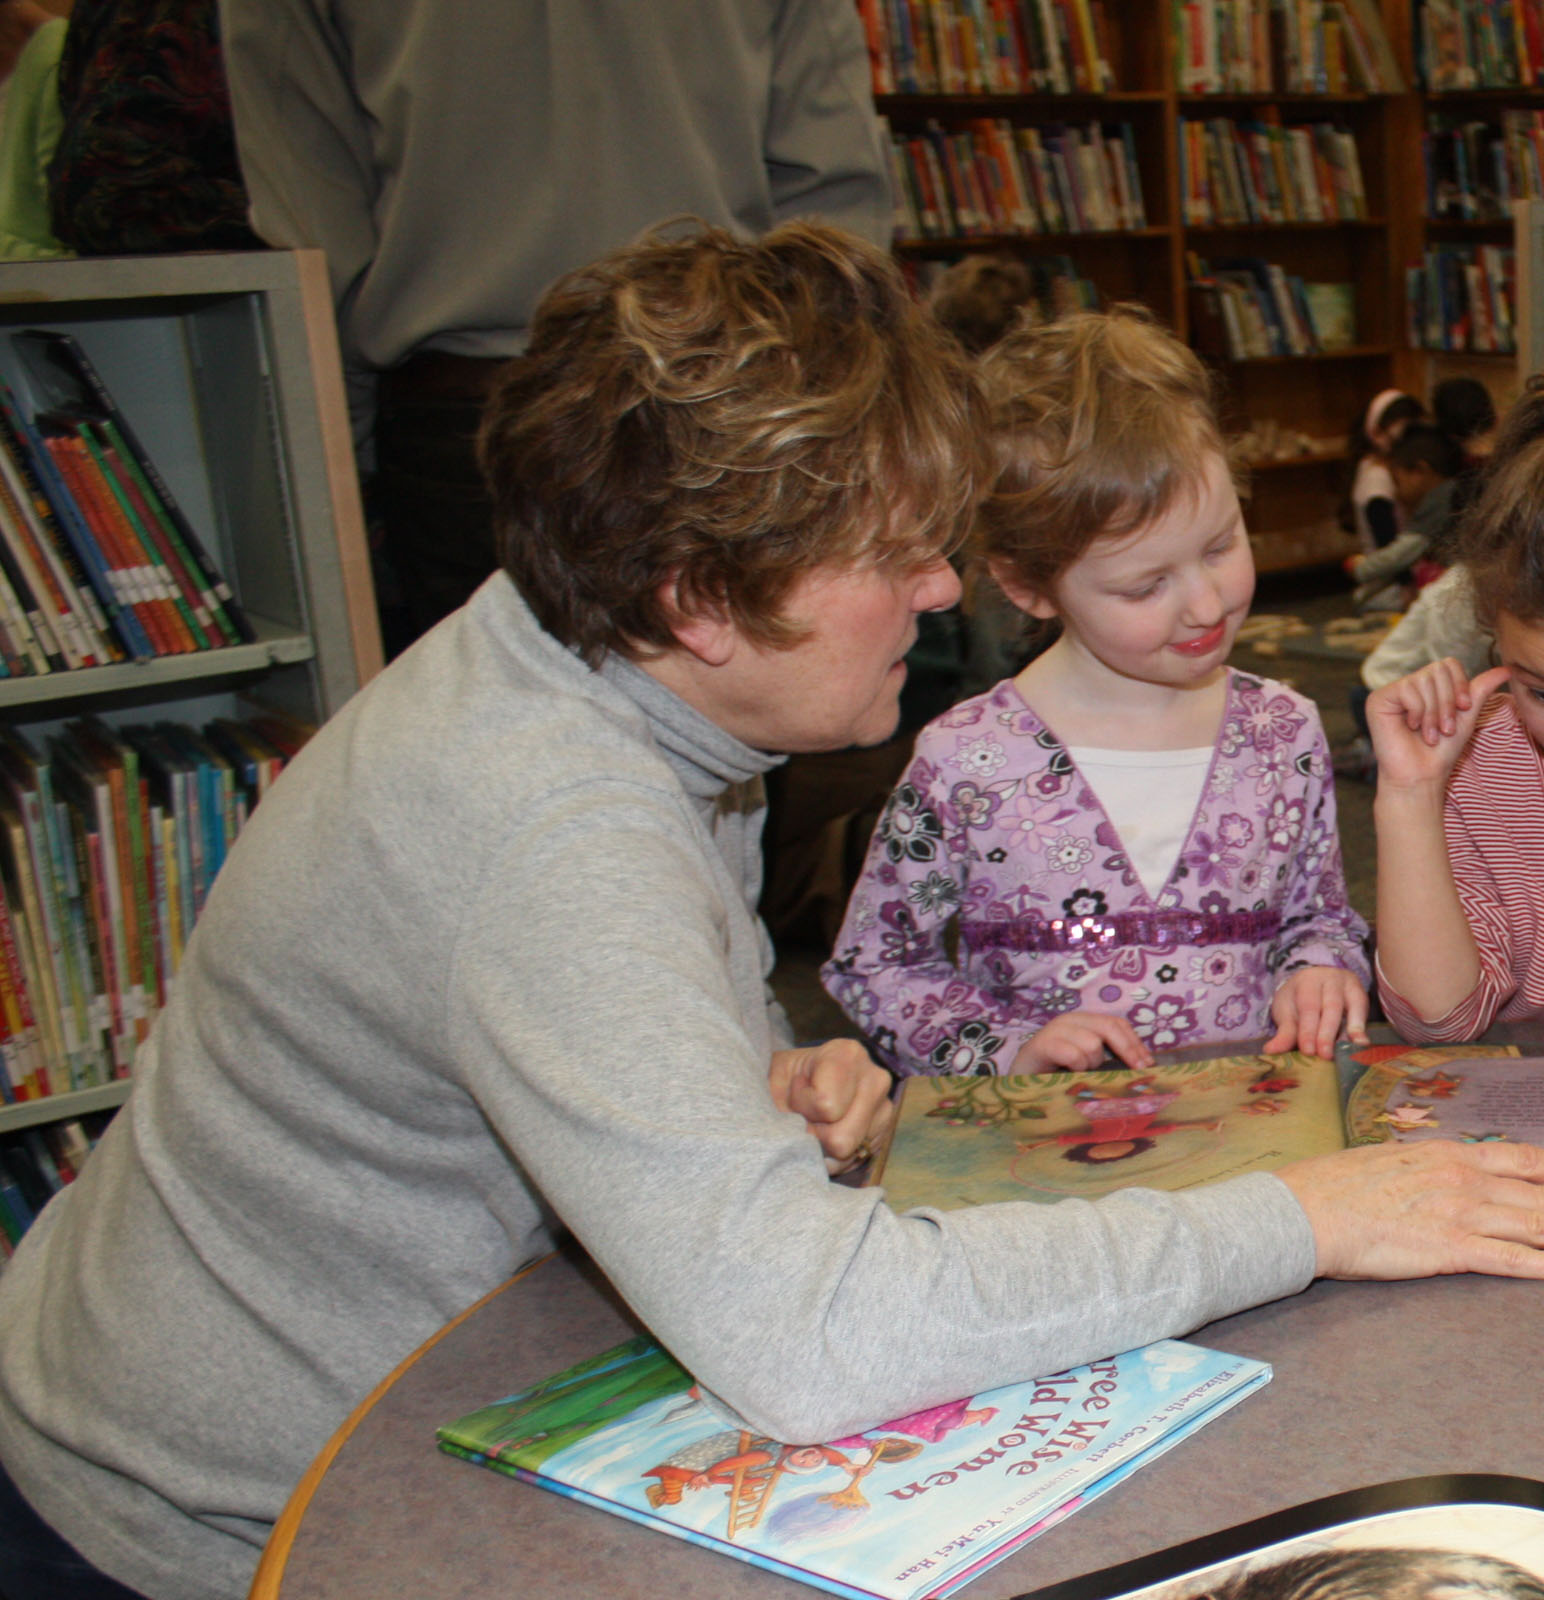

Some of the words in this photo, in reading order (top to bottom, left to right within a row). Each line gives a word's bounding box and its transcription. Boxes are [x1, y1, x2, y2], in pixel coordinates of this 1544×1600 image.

[1165, 1370, 1235, 1414] Elizabeth
[1149, 1407, 1168, 1424] T.
[885, 1412, 1061, 1503] Women
[1004, 1418, 1110, 1478] Wise
[1084, 1425, 1147, 1464] Corbett
[935, 1517, 1002, 1559] Yu-Mei
[893, 1557, 938, 1583] Han
